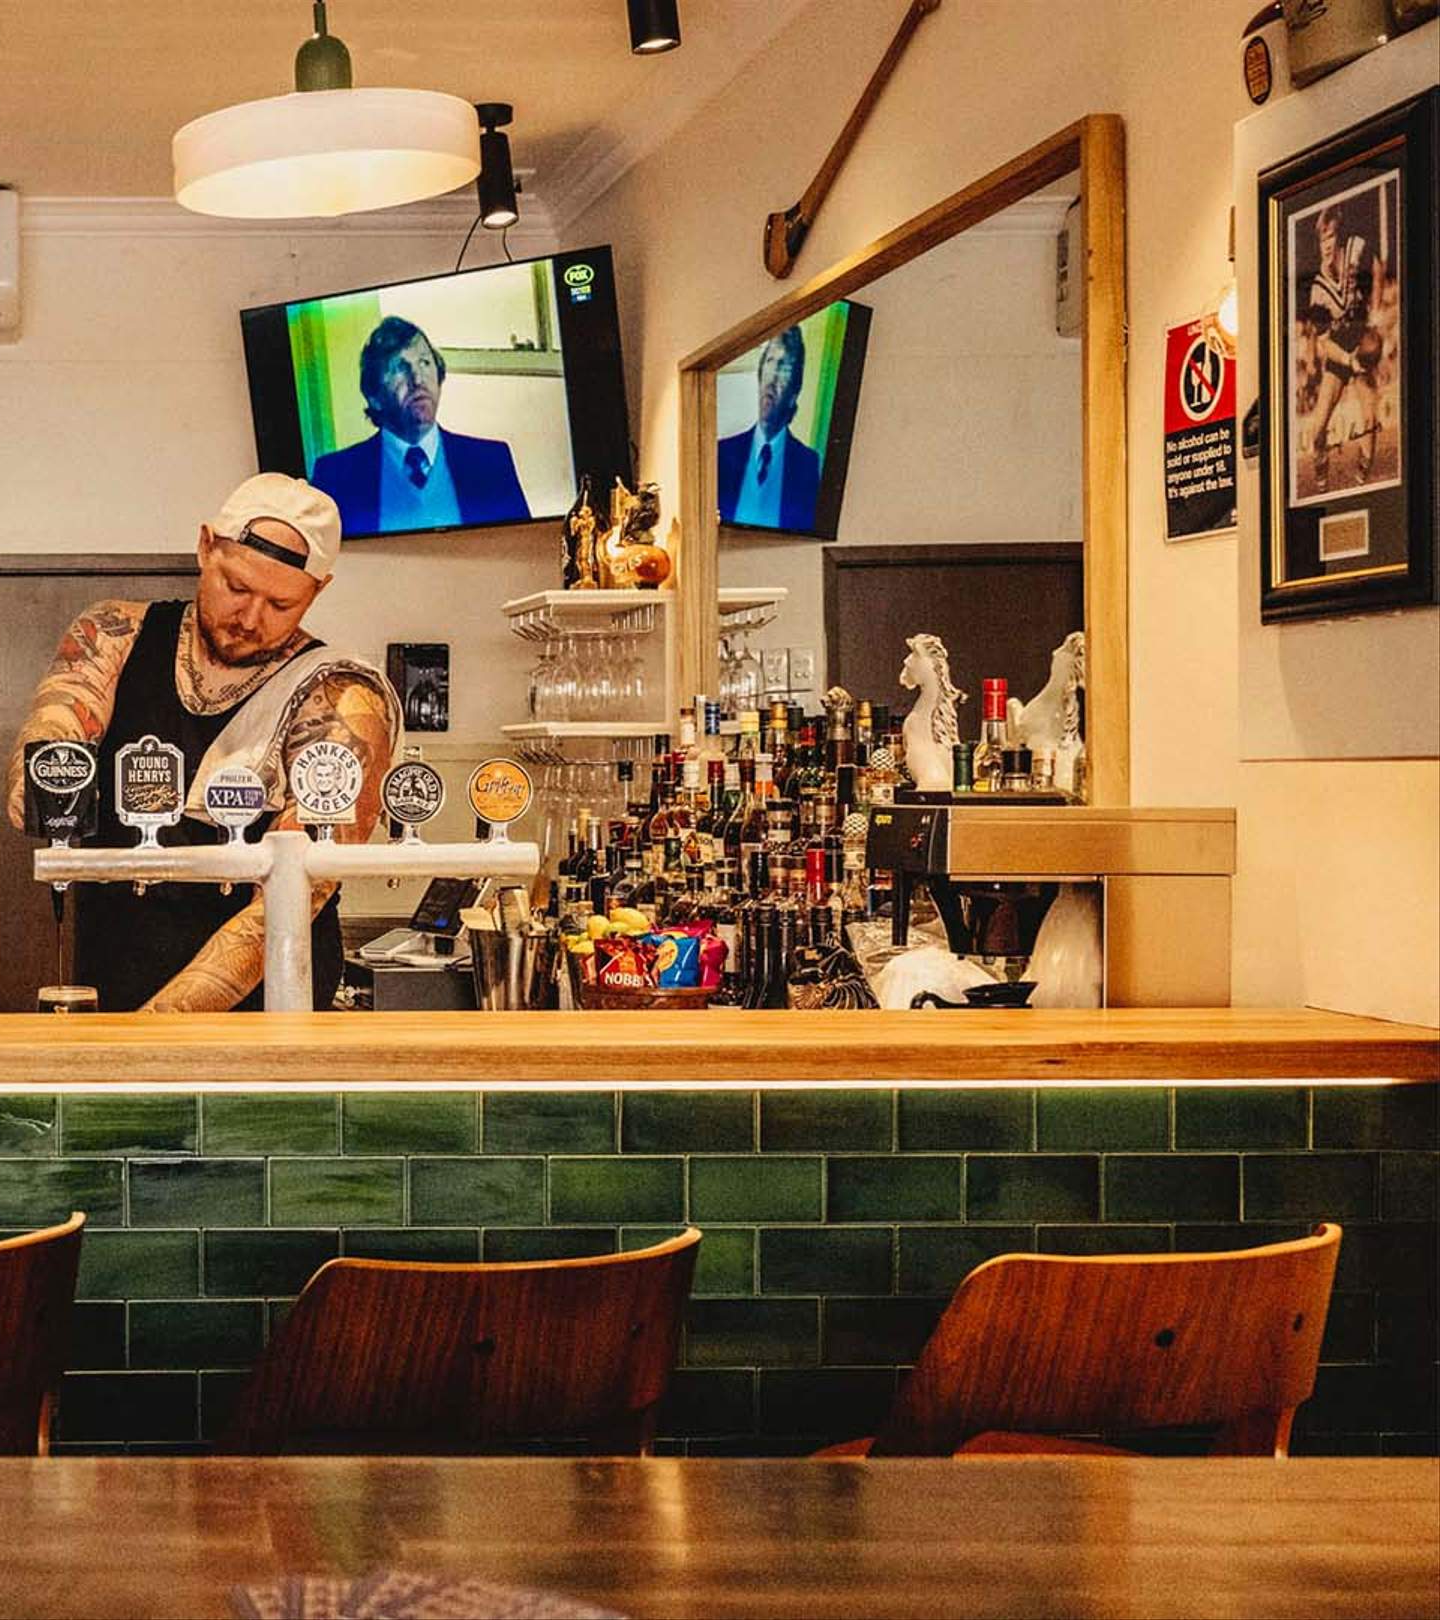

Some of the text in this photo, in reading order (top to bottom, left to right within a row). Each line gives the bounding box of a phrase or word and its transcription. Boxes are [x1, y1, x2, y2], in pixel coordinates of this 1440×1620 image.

[569, 269, 589, 281] FOX
[1166, 428, 1230, 453] No alcohol can be
[1167, 444, 1231, 468] sold or supplied to
[1168, 470, 1192, 484] anyone
[1194, 464, 1214, 477] under
[1180, 480, 1205, 498] against
[1206, 479, 1217, 491] the
[131, 756, 169, 769] YOUNG
[296, 744, 357, 769] HAWKE'S
[38, 764, 88, 777] GUINNESS
[128, 769, 172, 783] HENRYS
[210, 789, 244, 806] XPA
[302, 793, 351, 811] LAGER
